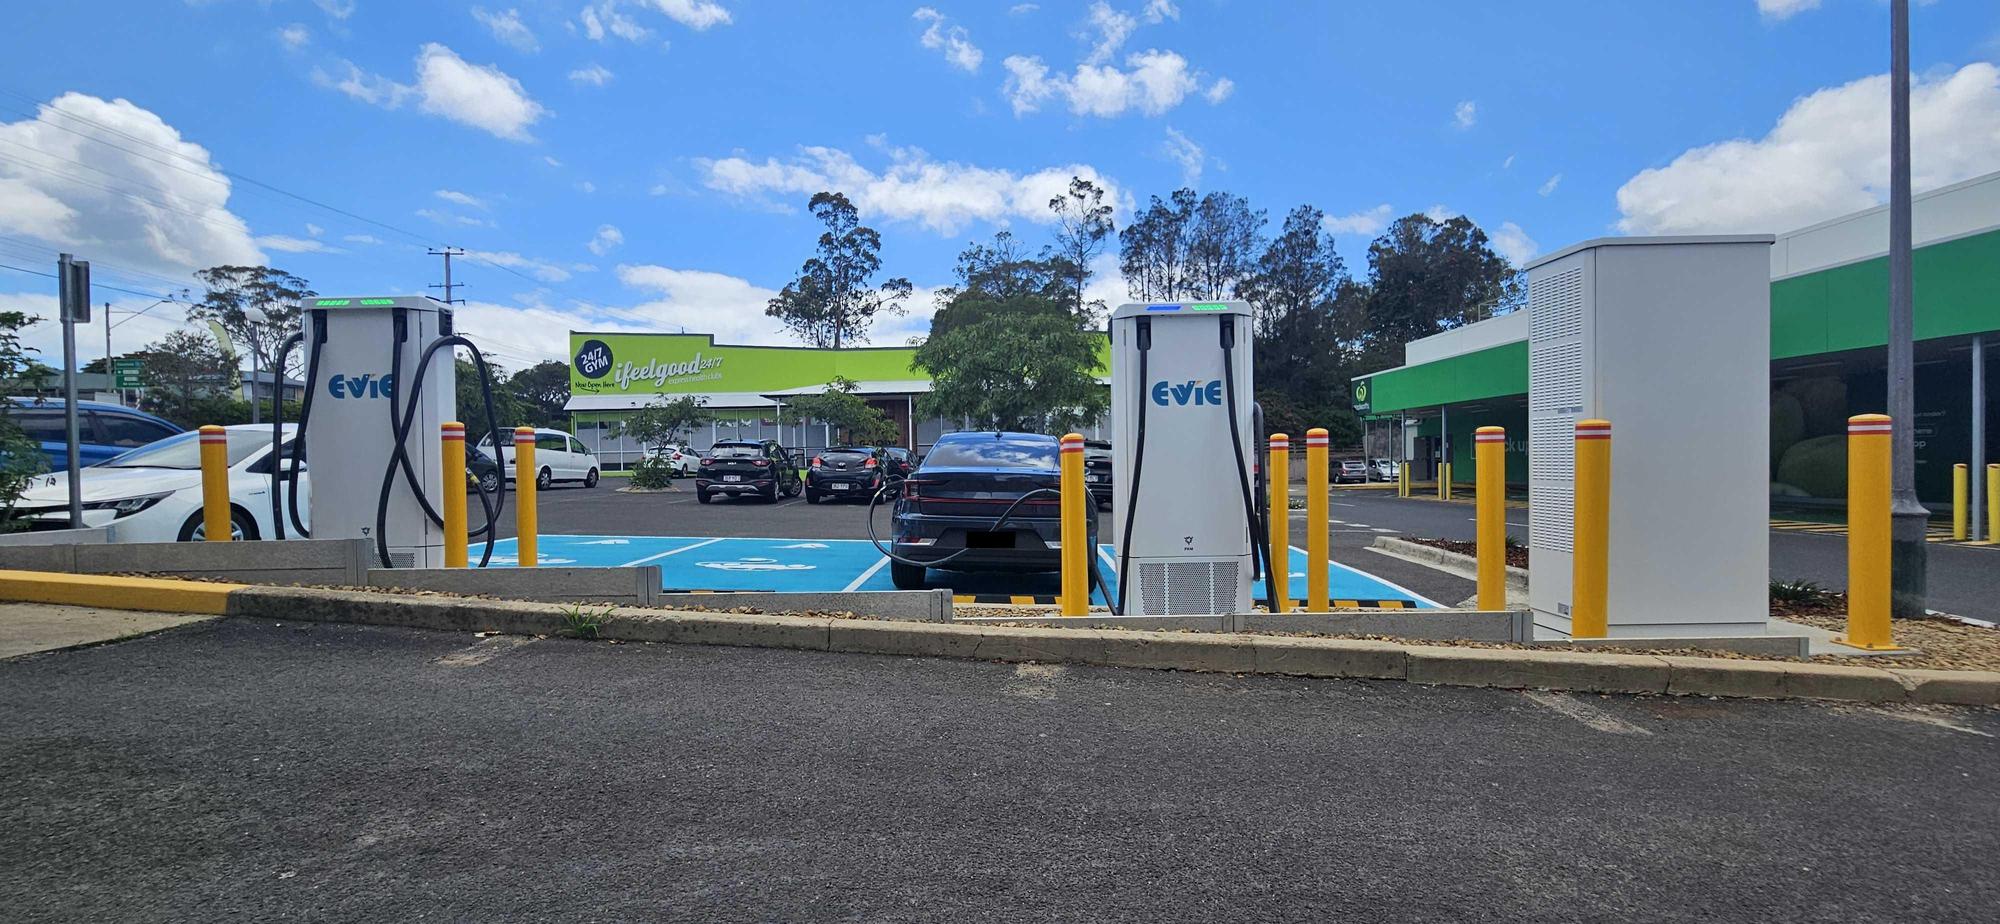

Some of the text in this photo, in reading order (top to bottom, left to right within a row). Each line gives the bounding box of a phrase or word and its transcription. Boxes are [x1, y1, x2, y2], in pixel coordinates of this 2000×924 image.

[581, 346, 602, 365] 24/7
[585, 355, 608, 373] GYM
[615, 352, 723, 390] ifeelgood 24/7
